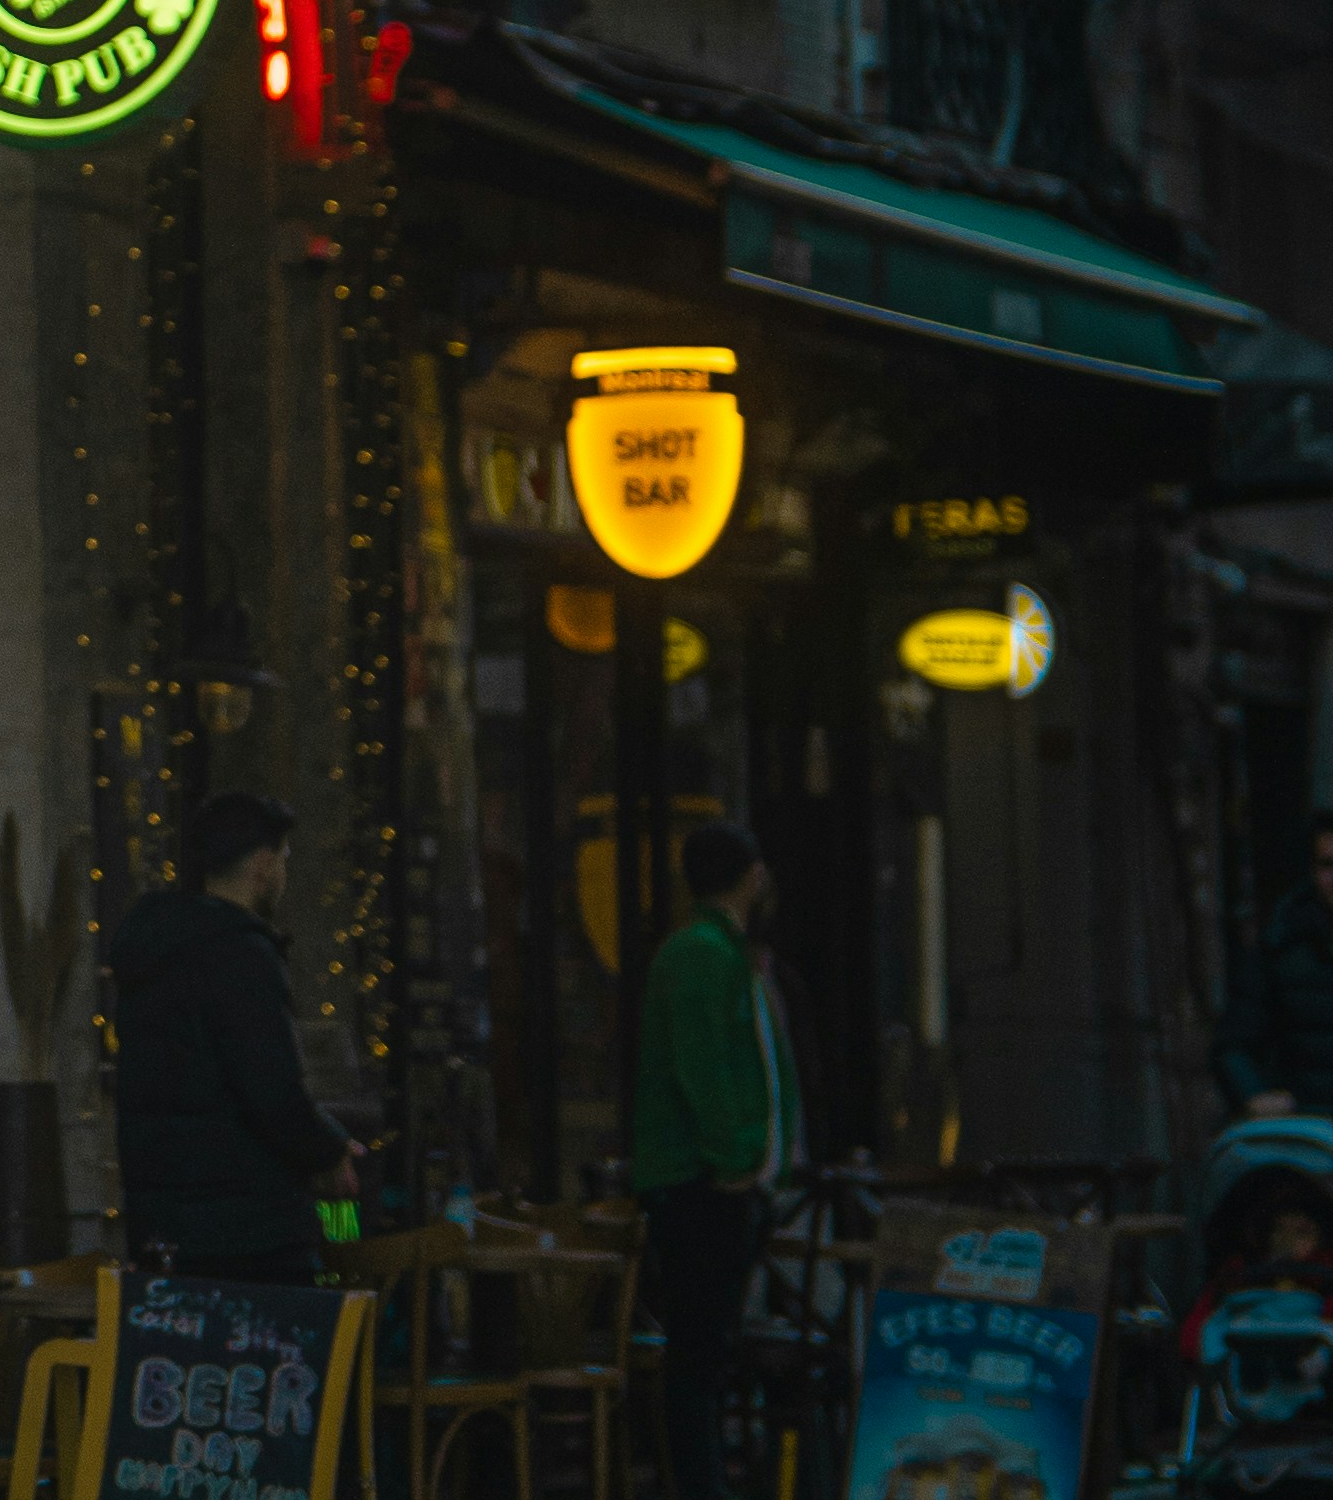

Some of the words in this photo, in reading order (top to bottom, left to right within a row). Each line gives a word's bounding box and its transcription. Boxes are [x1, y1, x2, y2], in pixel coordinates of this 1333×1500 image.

[52, 25, 158, 106] PUB
[615, 428, 699, 463] SHOT
[625, 475, 691, 507] BAR
[132, 1356, 319, 1436] BEER
[172, 1428, 263, 1478] DAY
